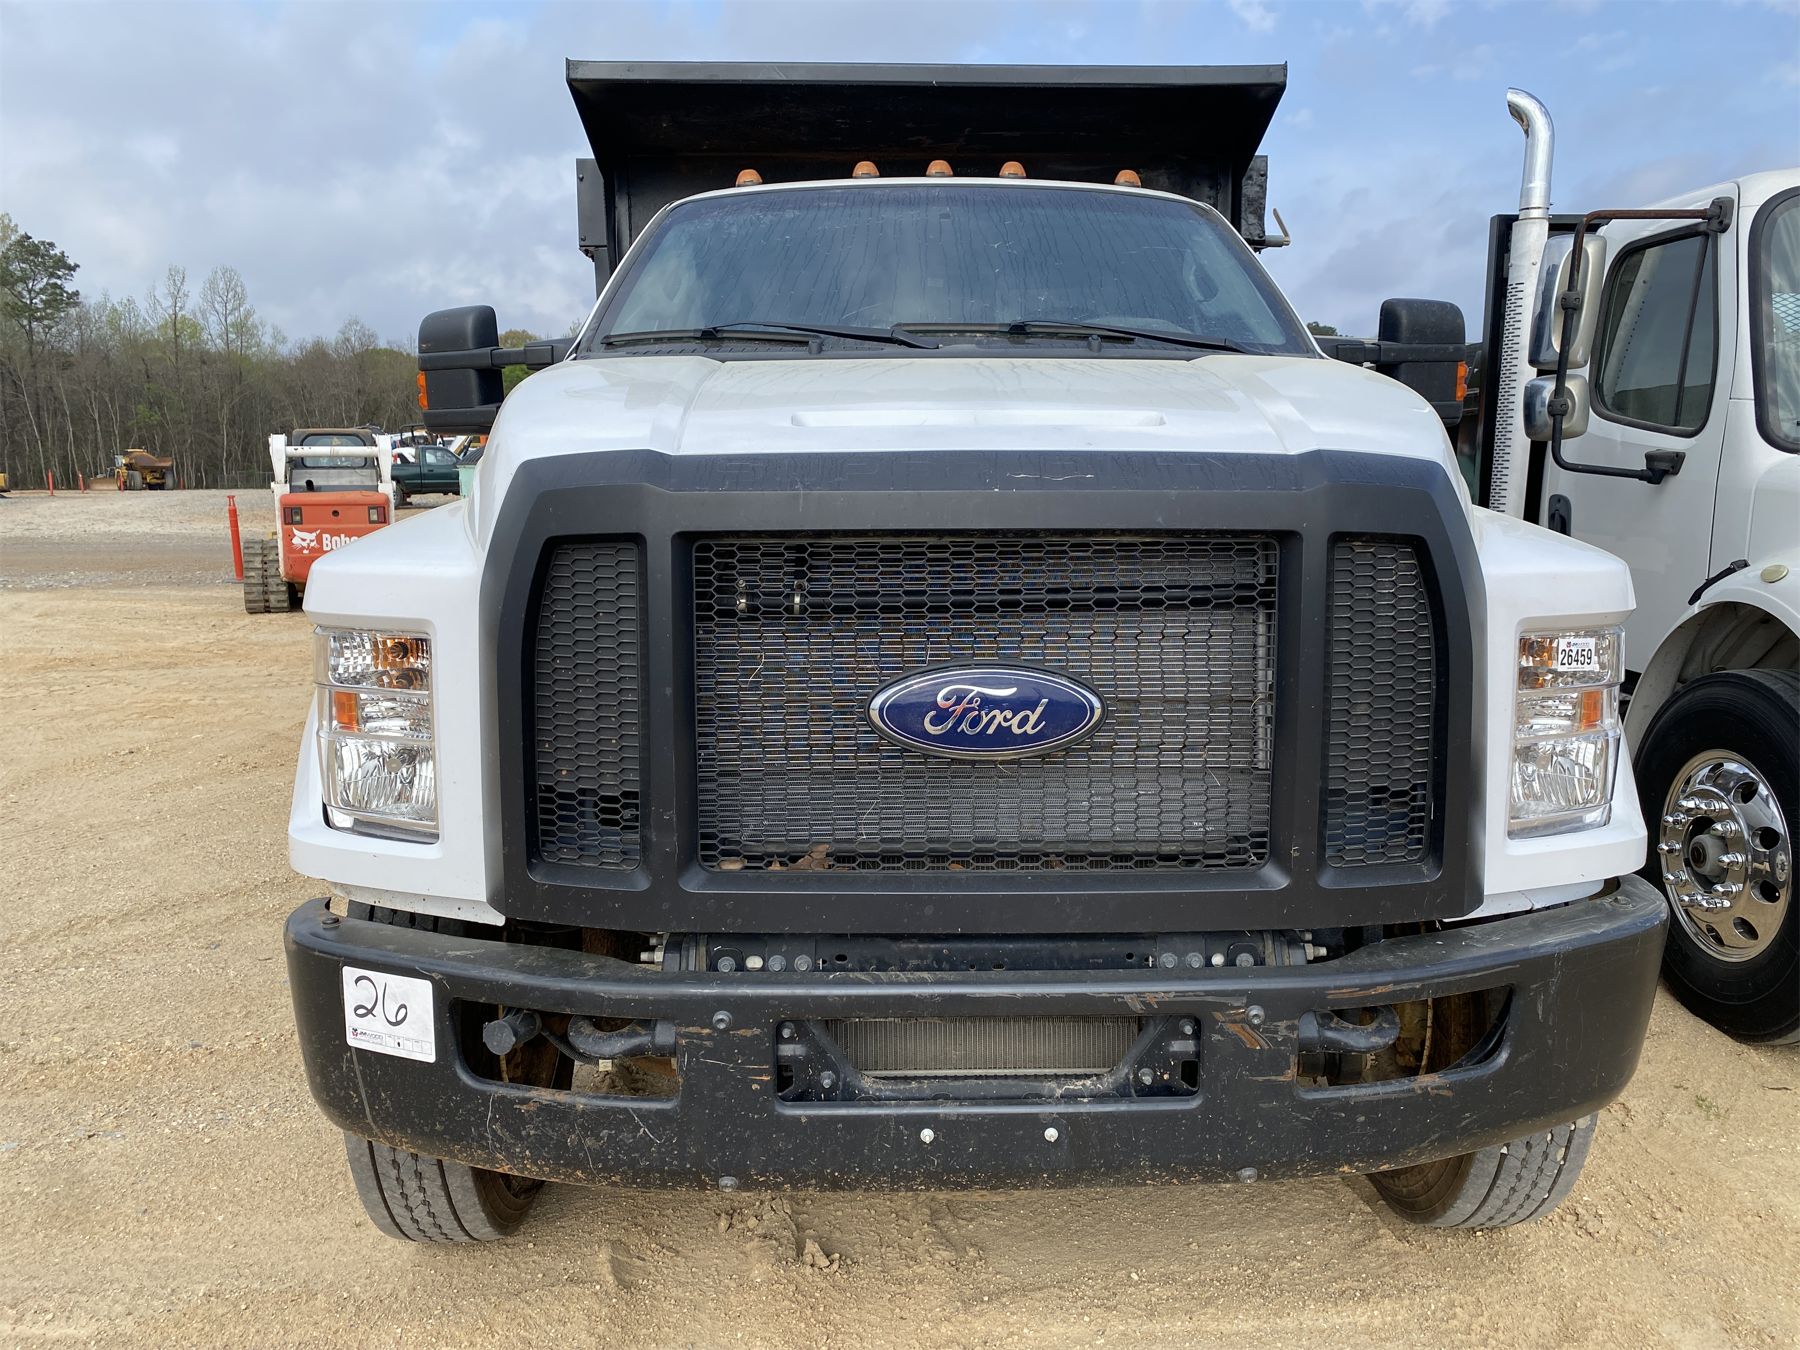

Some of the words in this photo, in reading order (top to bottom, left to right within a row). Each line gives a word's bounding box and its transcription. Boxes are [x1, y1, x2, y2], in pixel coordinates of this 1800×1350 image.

[1560, 648, 1593, 666] 26459
[923, 684, 1049, 736] Ford
[353, 975, 408, 1027] 26
